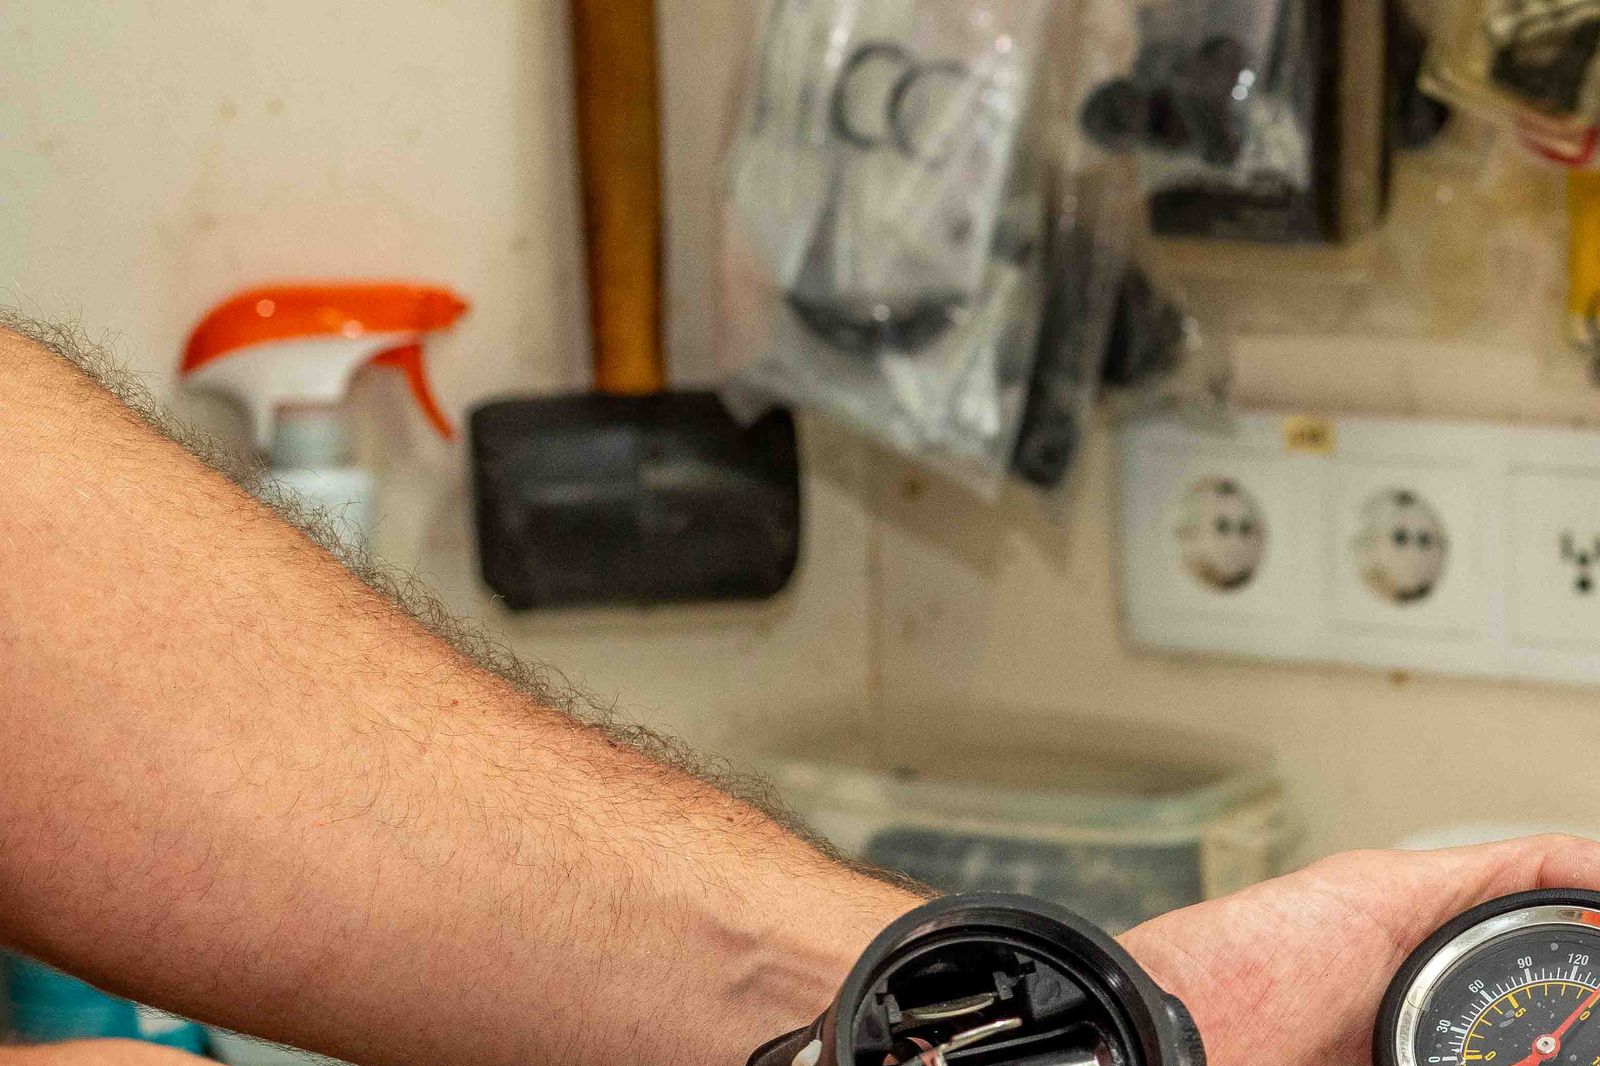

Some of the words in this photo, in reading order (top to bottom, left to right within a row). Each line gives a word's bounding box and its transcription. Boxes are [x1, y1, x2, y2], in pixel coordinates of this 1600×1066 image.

[1517, 956, 1533, 969] 90
[1567, 952, 1590, 966] 120
[1468, 979, 1485, 994] 60
[1514, 1007, 1527, 1018] 5
[1436, 1019, 1451, 1034] 30
[1484, 1050, 1497, 1061] 0
